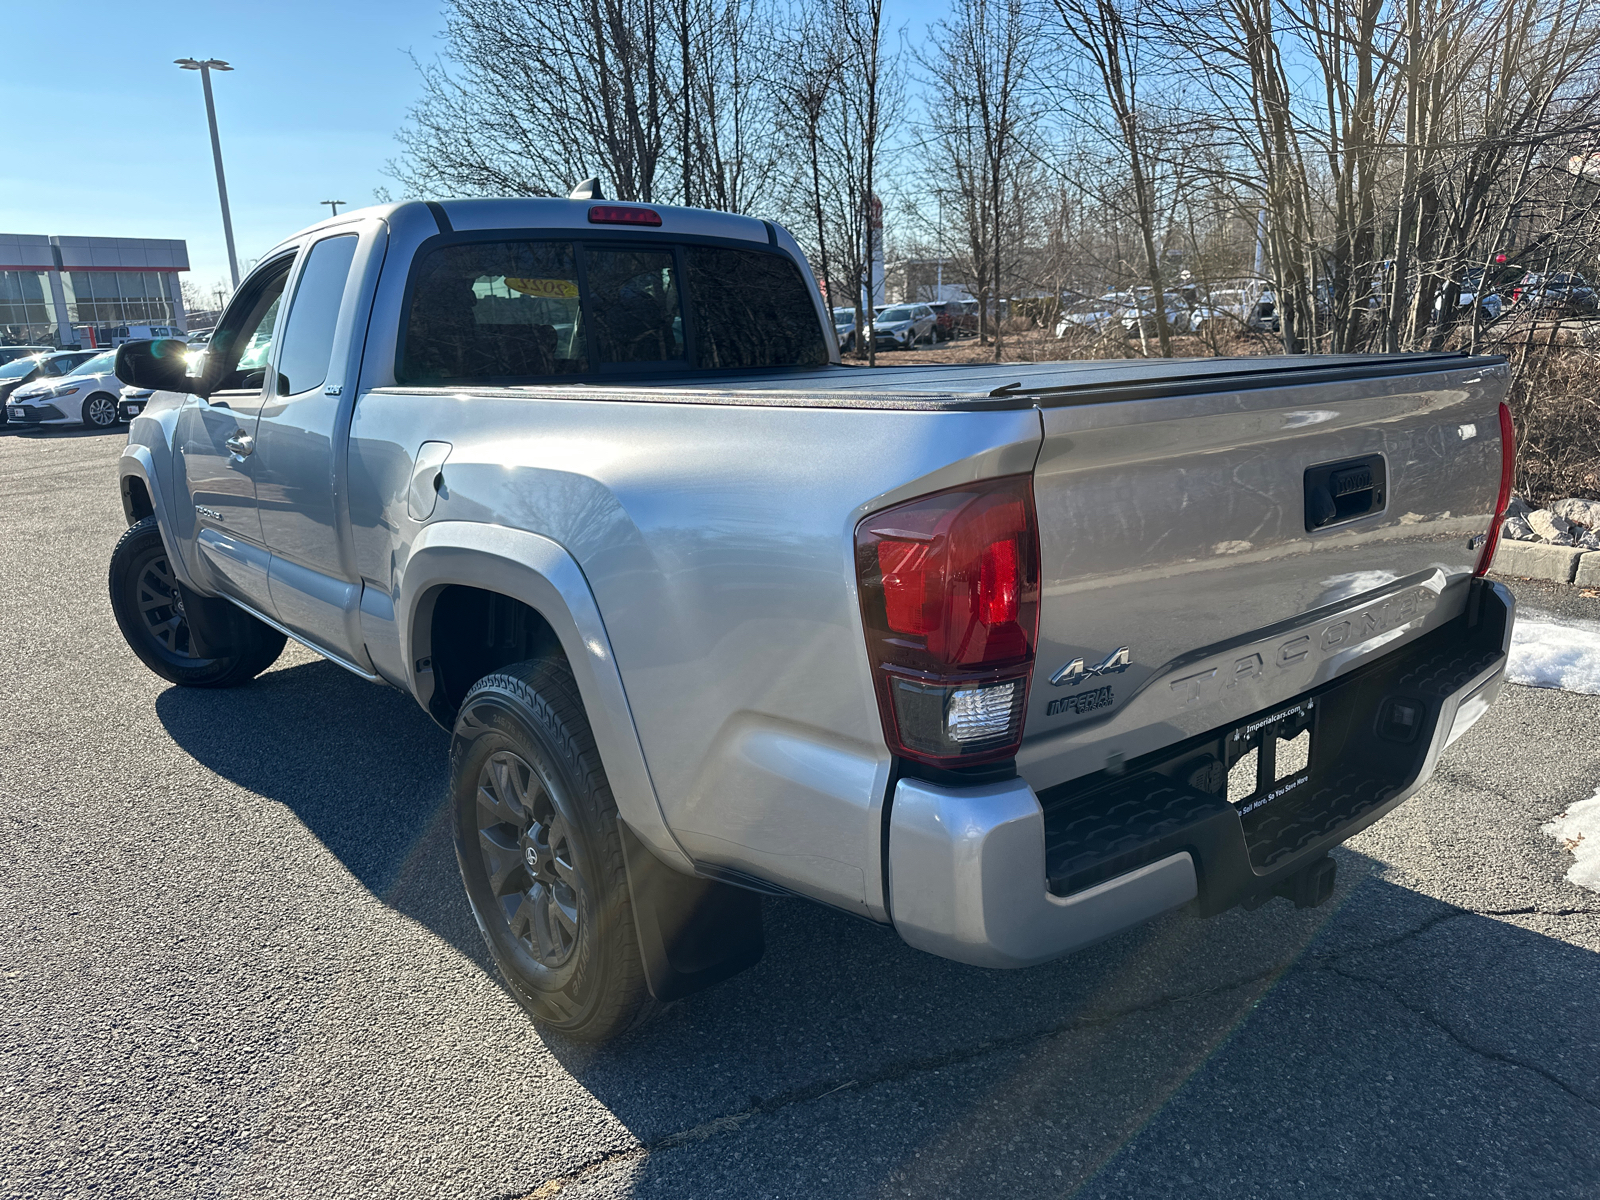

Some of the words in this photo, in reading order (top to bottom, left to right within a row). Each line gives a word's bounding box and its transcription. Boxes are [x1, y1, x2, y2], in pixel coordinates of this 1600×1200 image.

[1337, 472, 1375, 494] TOYOTA
[1168, 590, 1420, 703] TACOMA
[1046, 685, 1114, 716] IMPERIAL
[1246, 705, 1301, 733] Imperialcars.com
[1242, 803, 1253, 816] Sell
[1253, 796, 1268, 809] More,
[1268, 792, 1275, 802] So
[1275, 786, 1285, 797] You
[1285, 781, 1296, 793] Save
[1296, 775, 1309, 786] More
